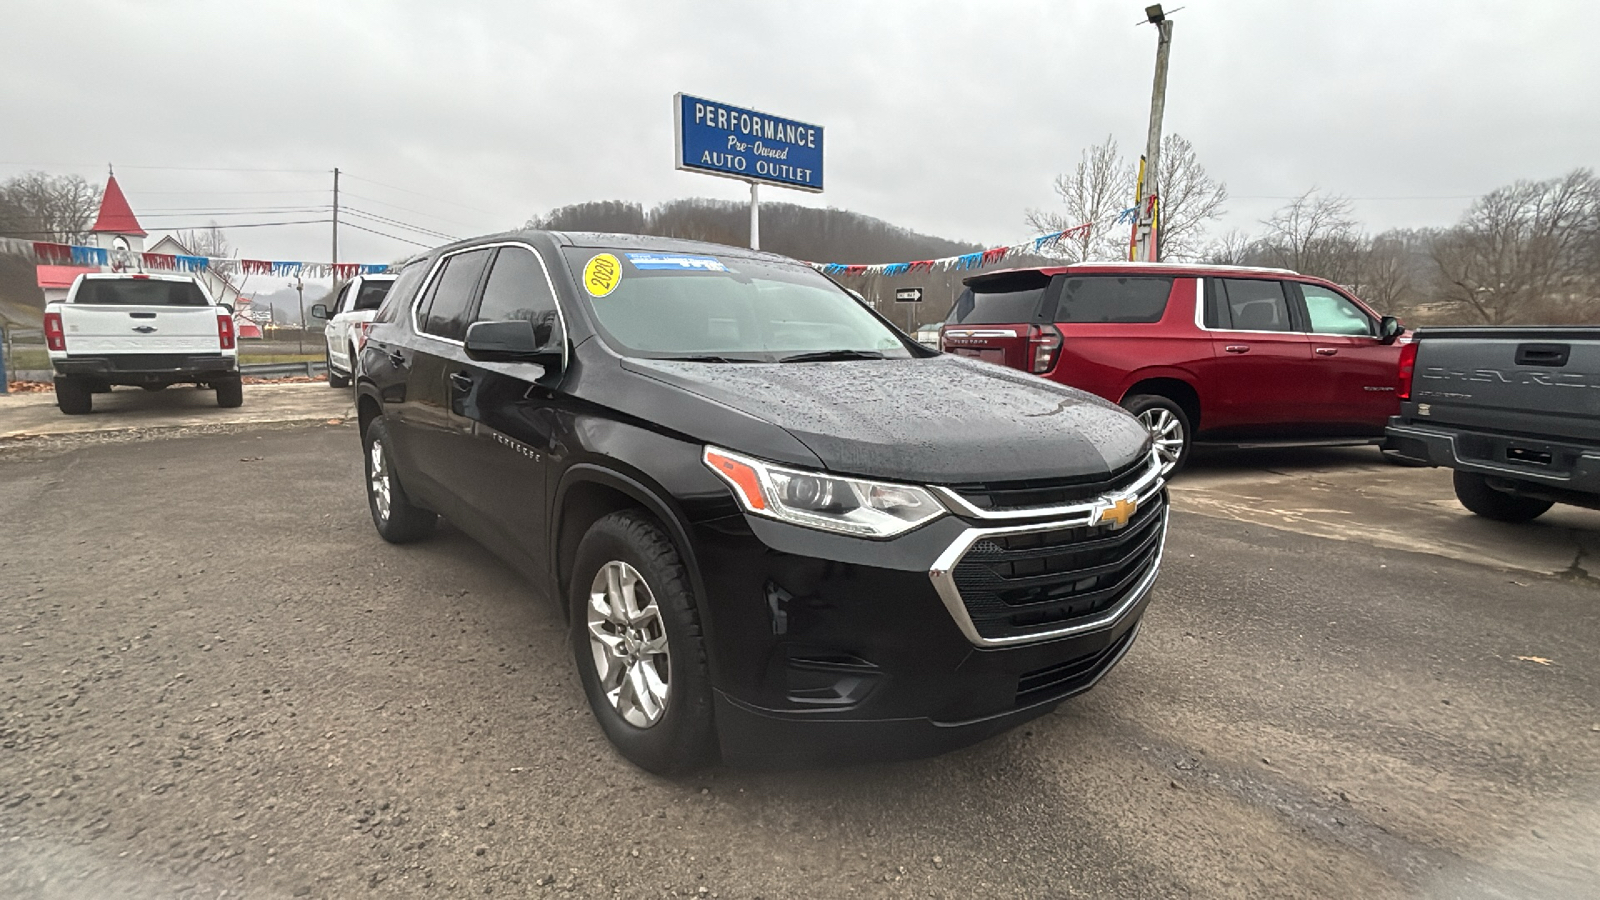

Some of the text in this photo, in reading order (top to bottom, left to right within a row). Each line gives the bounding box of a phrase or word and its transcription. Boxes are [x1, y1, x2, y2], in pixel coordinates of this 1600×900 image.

[695, 103, 816, 149] PERFORMANCE
[727, 135, 789, 160] Pre-Owned
[701, 150, 813, 183] AUTO OUTLET
[591, 258, 614, 290] 2020
